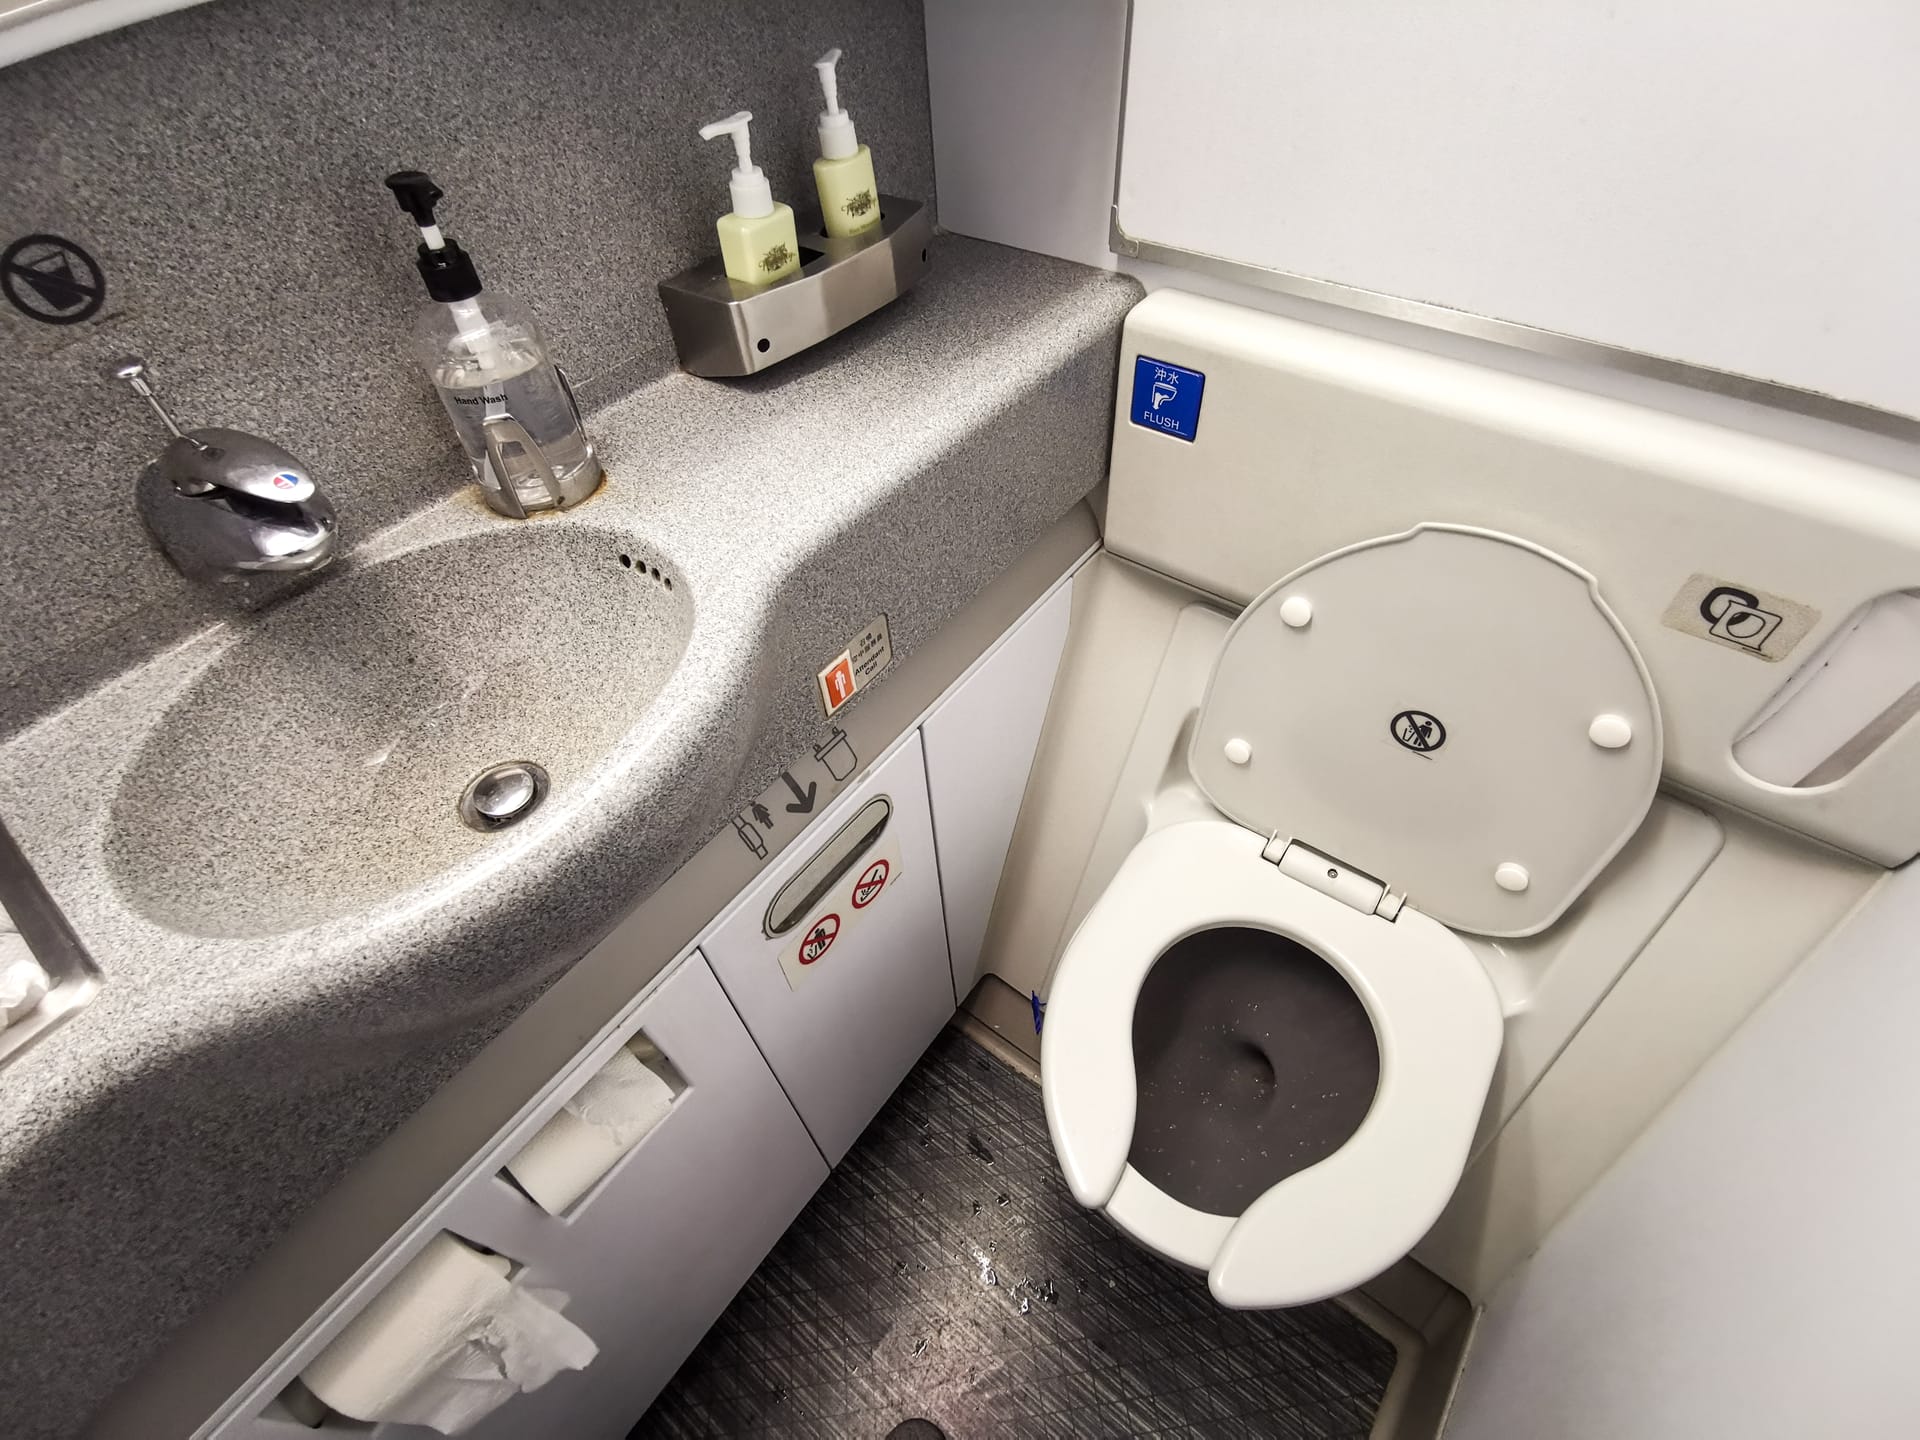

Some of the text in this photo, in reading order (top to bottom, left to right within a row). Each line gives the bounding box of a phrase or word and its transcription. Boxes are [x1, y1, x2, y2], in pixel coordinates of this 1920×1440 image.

[454, 393, 508, 405] Hand Wash
[1143, 410, 1180, 430] FLUSH
[855, 646, 885, 676] Attendant
[864, 661, 878, 675] Call
